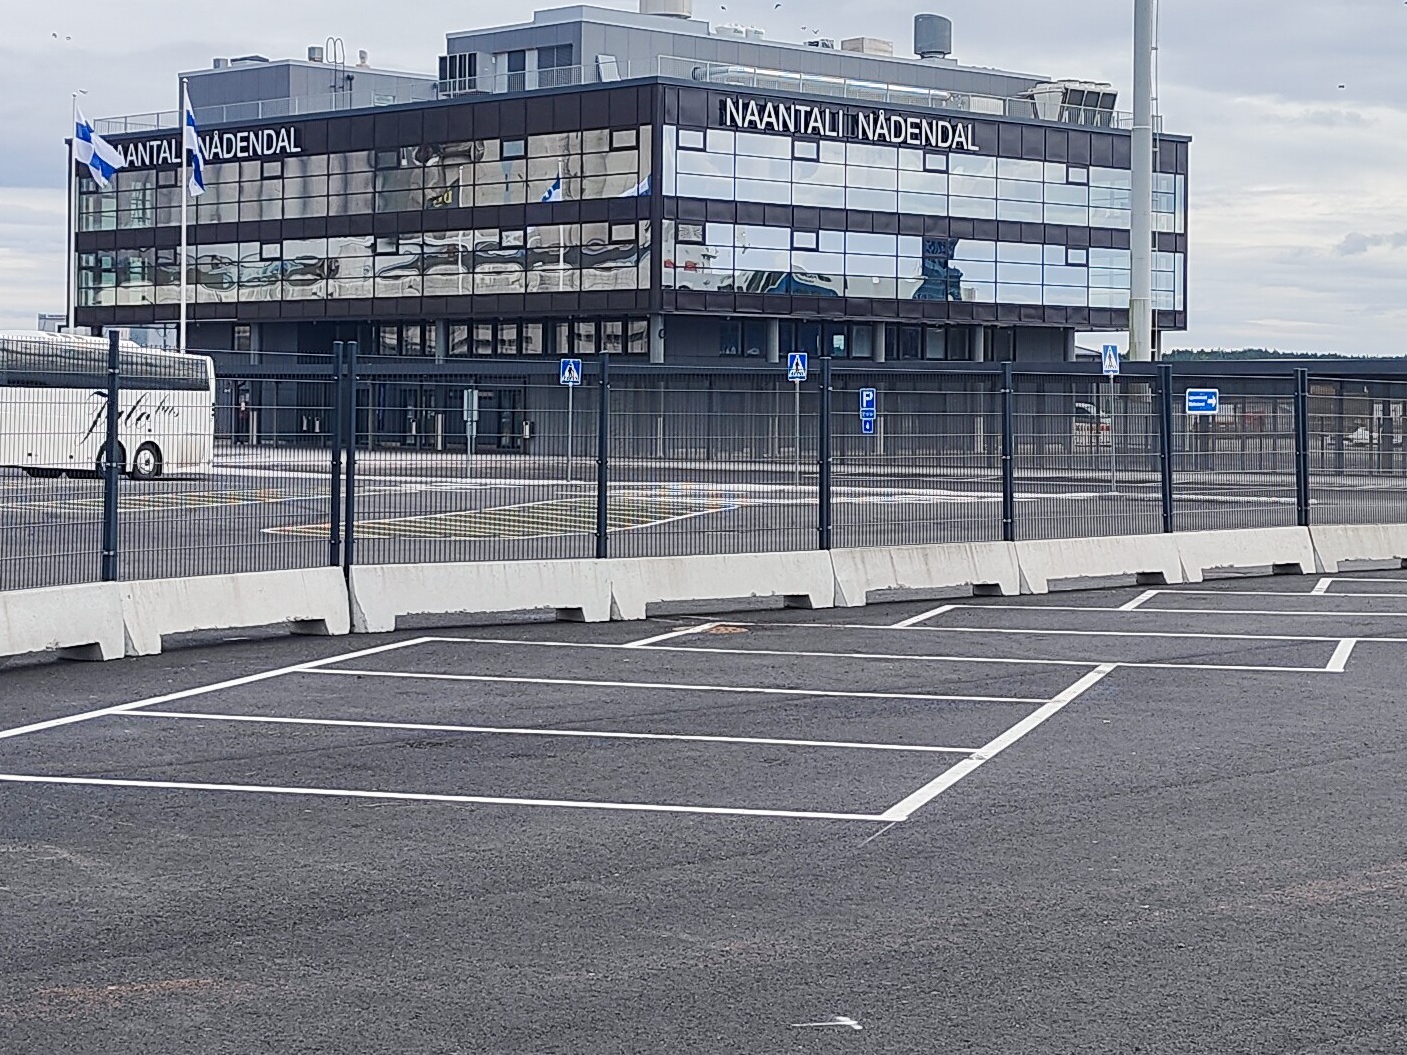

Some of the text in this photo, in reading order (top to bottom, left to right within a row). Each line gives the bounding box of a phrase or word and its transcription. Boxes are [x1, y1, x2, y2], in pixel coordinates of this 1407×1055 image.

[726, 97, 980, 151] NAANTALI NÅDENDAL
[114, 126, 302, 167] AANTAL NÅDENDAL
[863, 391, 874, 408] P
